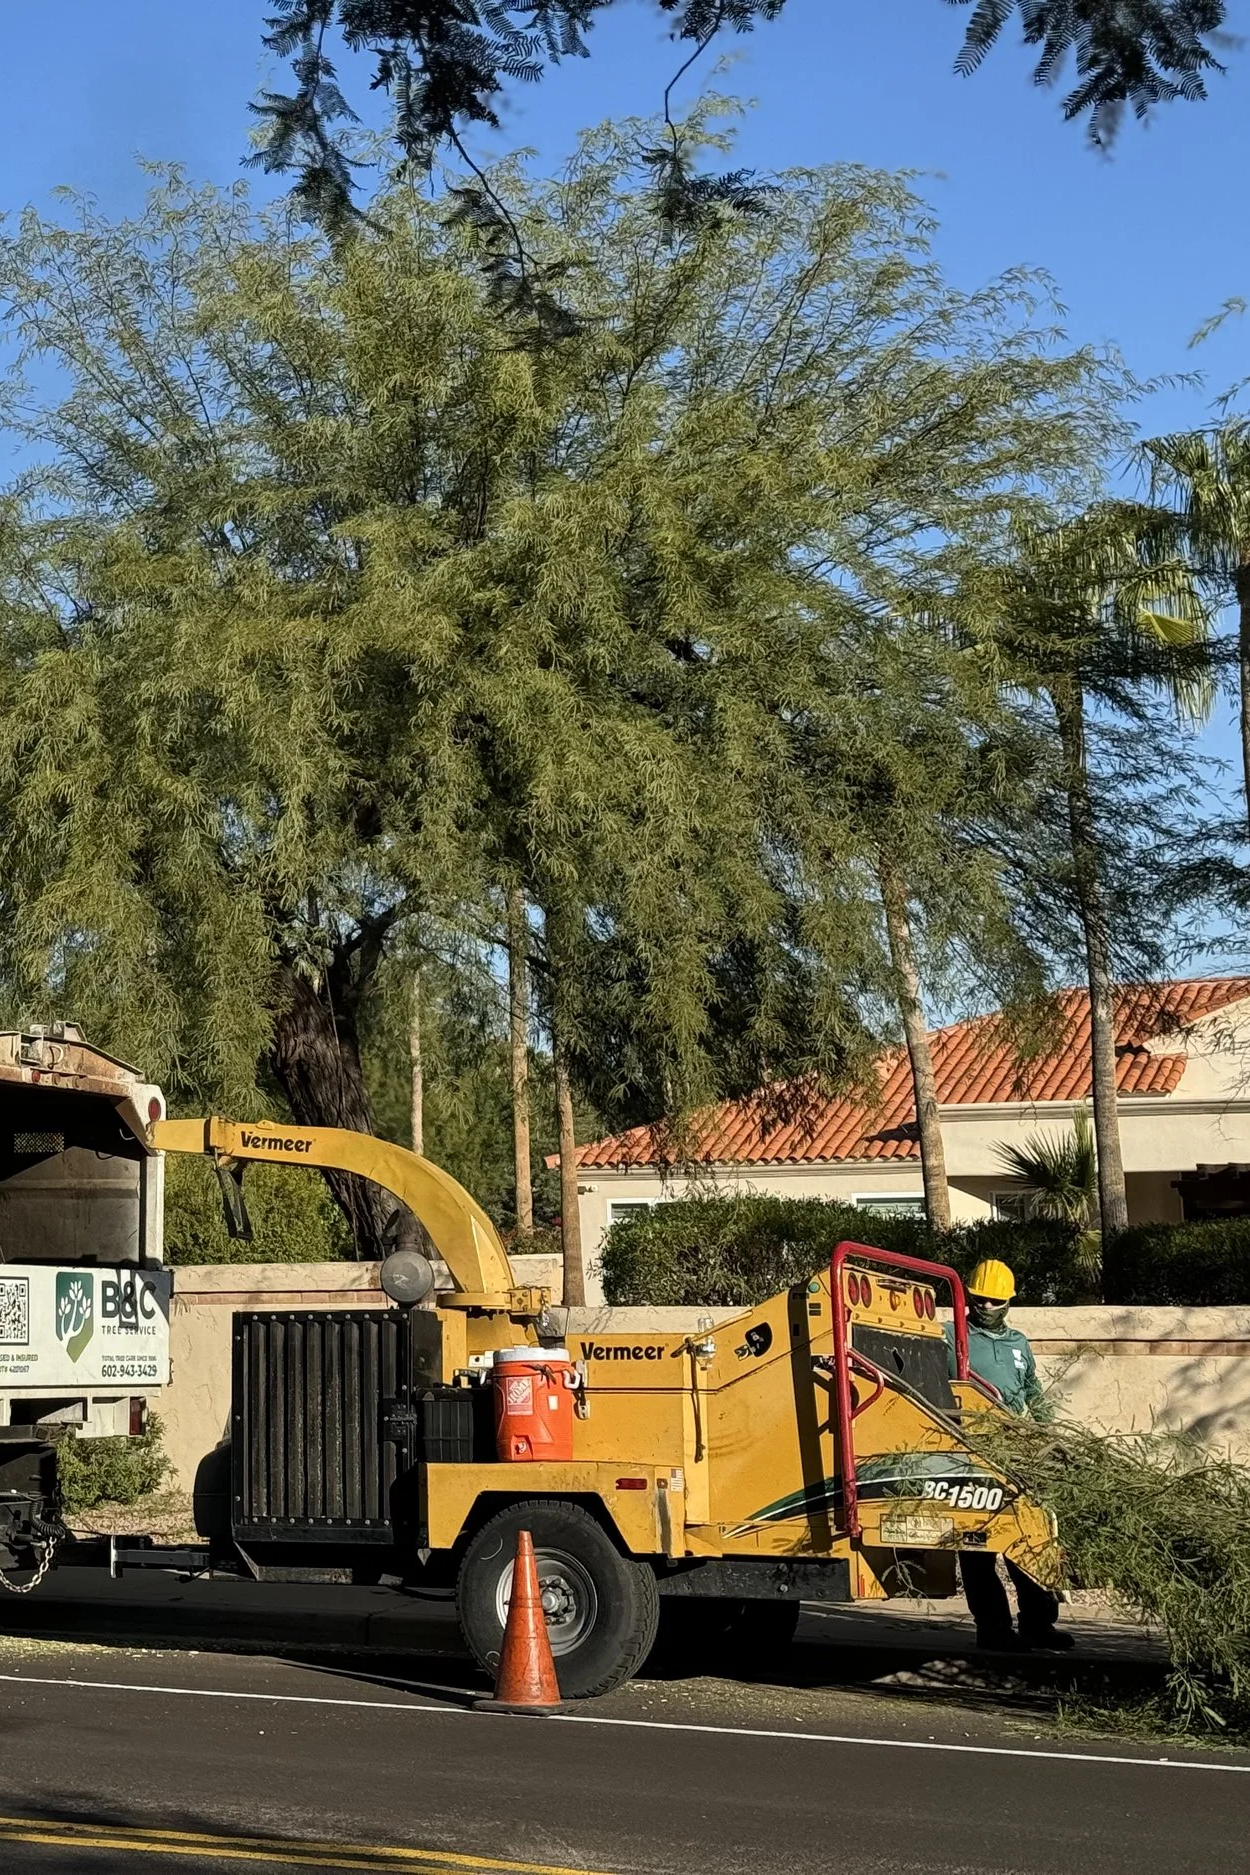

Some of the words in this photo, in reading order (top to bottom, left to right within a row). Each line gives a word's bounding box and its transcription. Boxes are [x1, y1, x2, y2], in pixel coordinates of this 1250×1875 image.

[240, 1131, 313, 1153] Vermeer
[101, 1280, 158, 1320] B&C
[101, 1325, 122, 1335] TREE
[125, 1325, 157, 1335] SERVICE
[15, 1353, 39, 1362] INSURED
[580, 1342, 666, 1361] Vermeer
[101, 1364, 158, 1378] 602-943-3429
[922, 1480, 1004, 1511] BC1500
